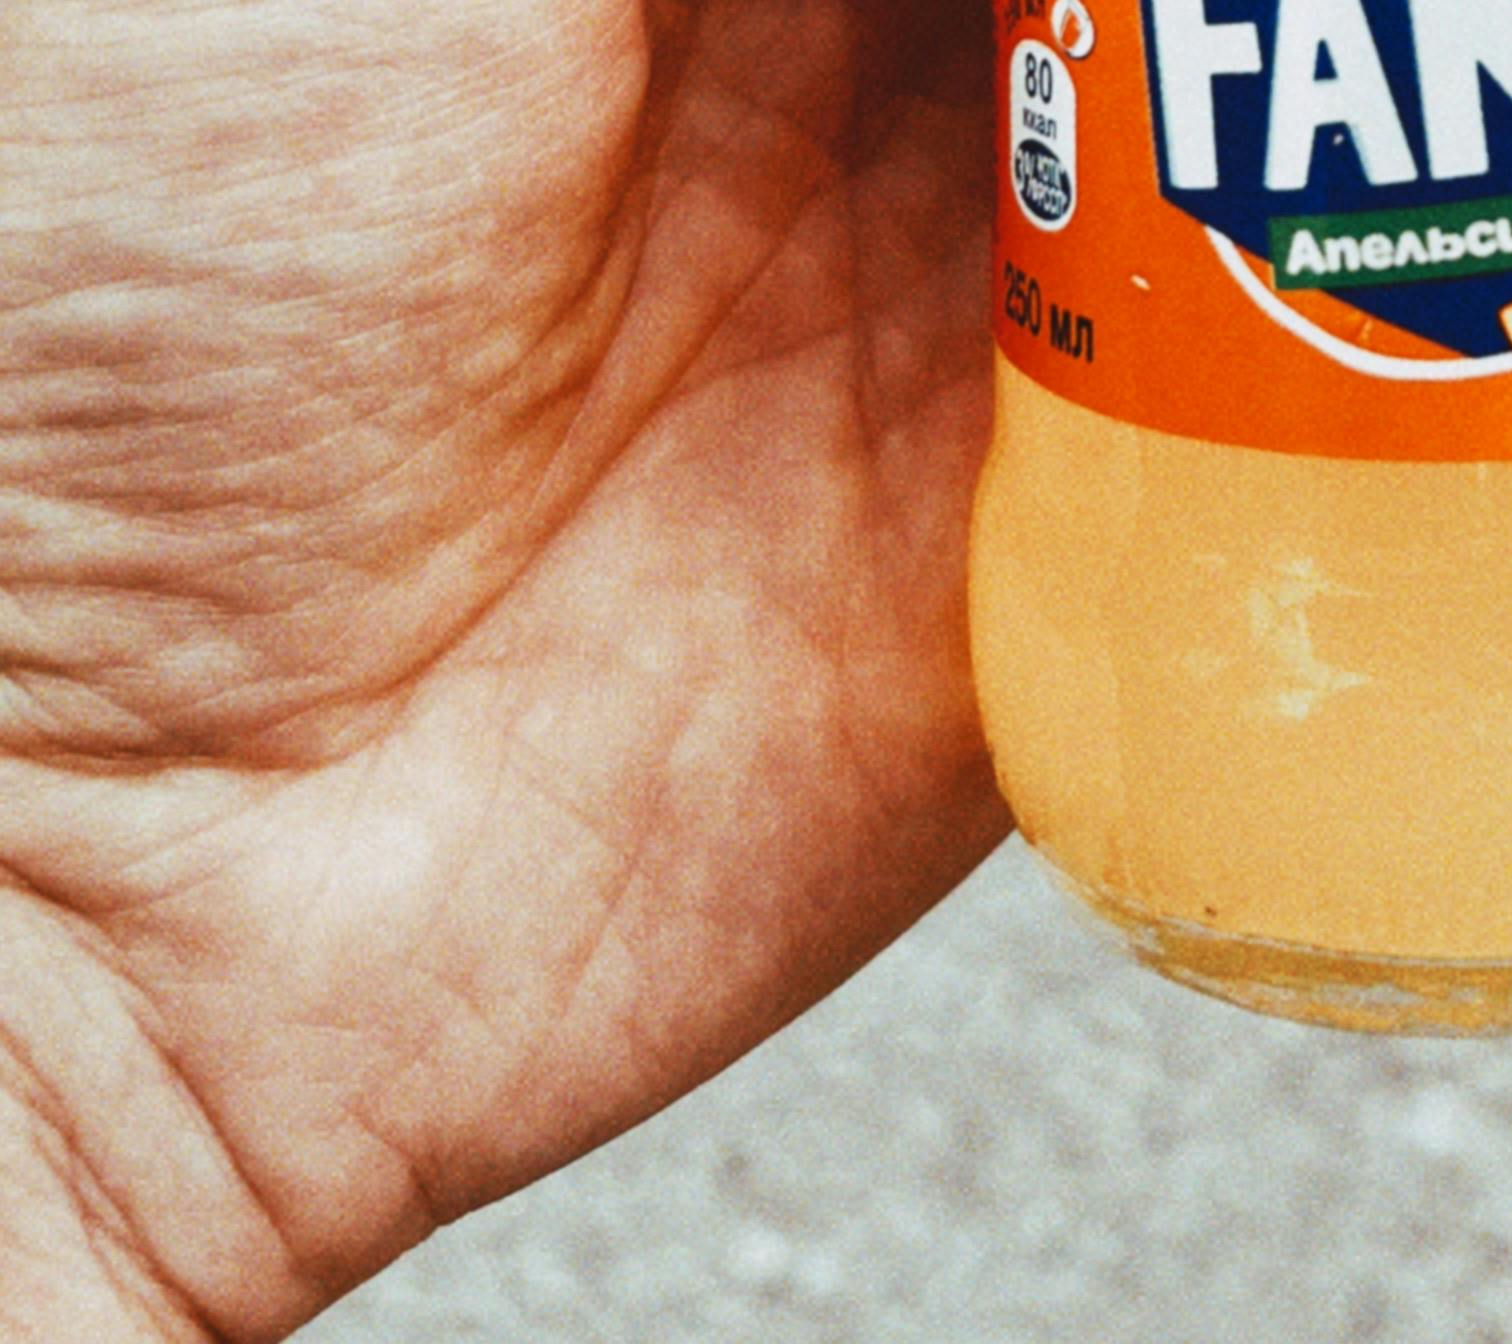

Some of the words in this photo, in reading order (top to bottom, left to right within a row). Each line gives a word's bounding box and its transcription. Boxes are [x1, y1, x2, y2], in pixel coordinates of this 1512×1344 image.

[1024, 51, 1054, 104] 80
[1022, 105, 1058, 141] ккал
[1003, 259, 1042, 338] 250
